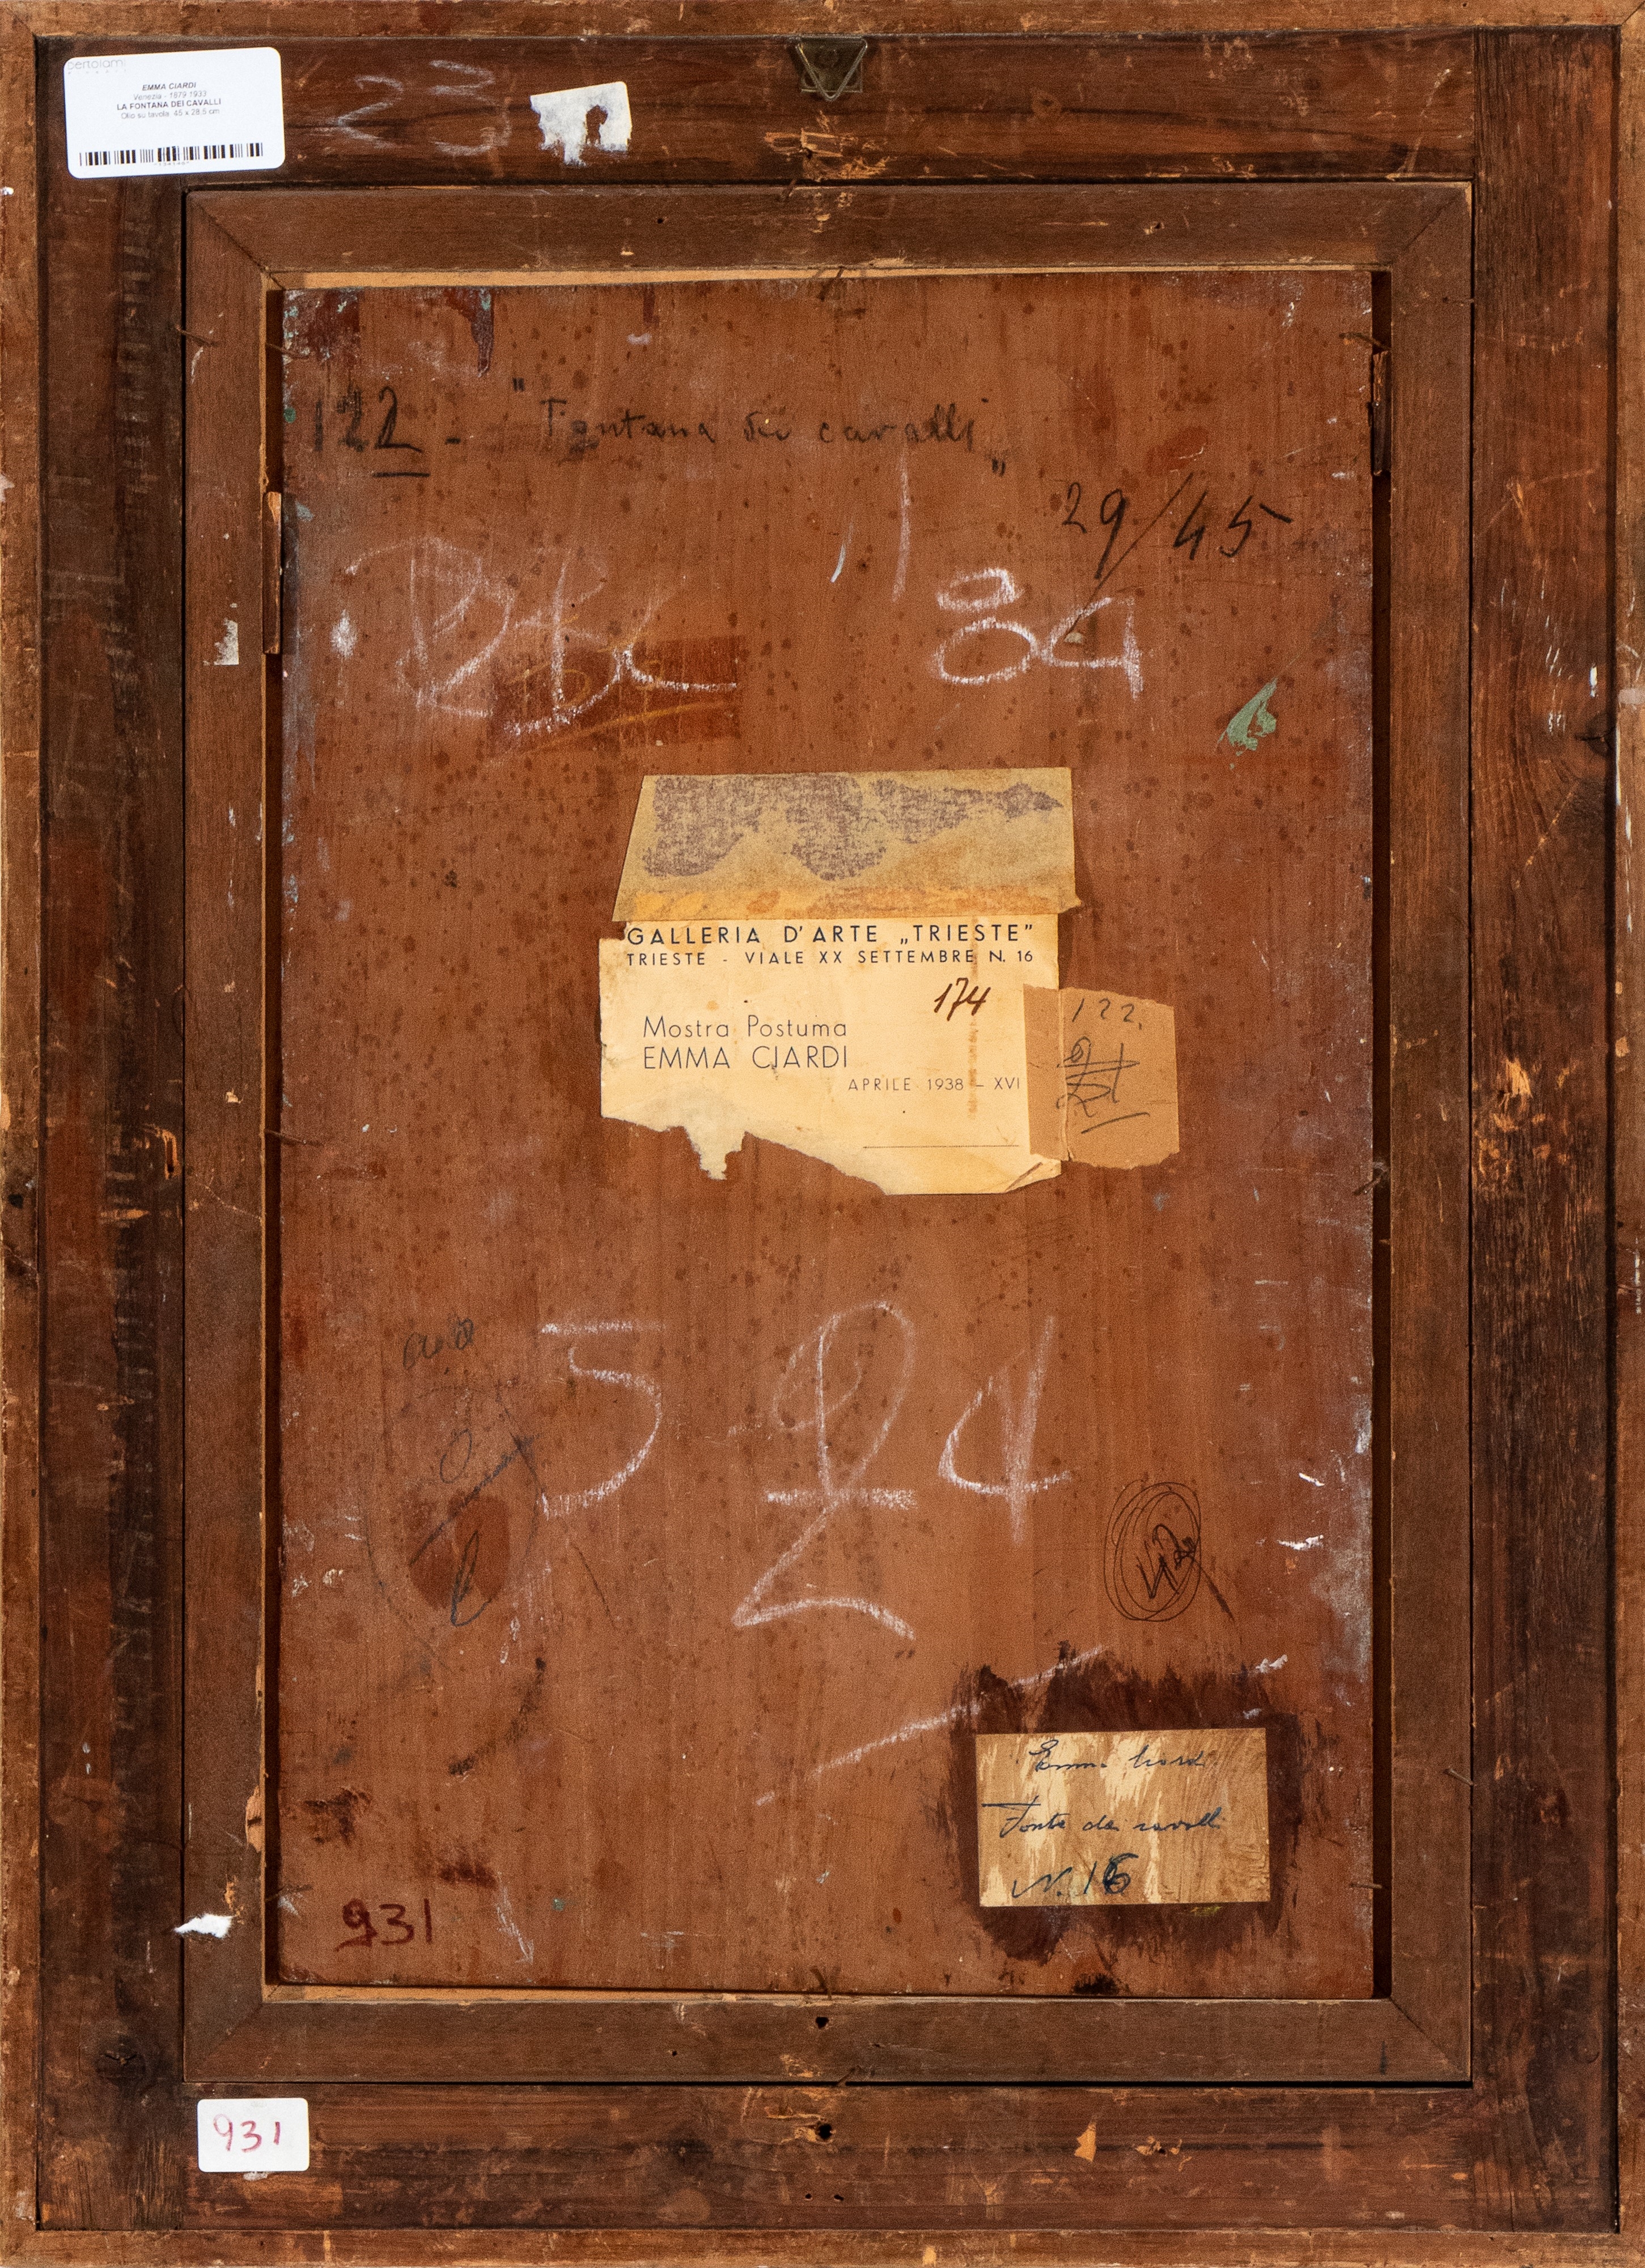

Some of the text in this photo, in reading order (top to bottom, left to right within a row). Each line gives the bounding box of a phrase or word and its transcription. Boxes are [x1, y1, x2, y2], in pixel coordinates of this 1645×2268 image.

[186, 98, 222, 107] CAVALLI
[628, 925, 760, 945] GALLERIA
[627, 952, 705, 966] TRIESTE
[745, 951, 804, 964] VIALE
[819, 951, 842, 963] XX
[858, 949, 973, 963] SETTEMBRE
[989, 949, 1006, 962] N.
[1017, 950, 1033, 962] 16
[934, 978, 992, 1021] 174
[643, 1014, 847, 1038] Mostra Postuma
[643, 1045, 847, 1069] EMMA CIARDI
[848, 1078, 911, 1091] APRILE
[928, 1078, 964, 1090] 1938
[994, 1077, 1020, 1090] XVI
[213, 2113, 281, 2153] 931
